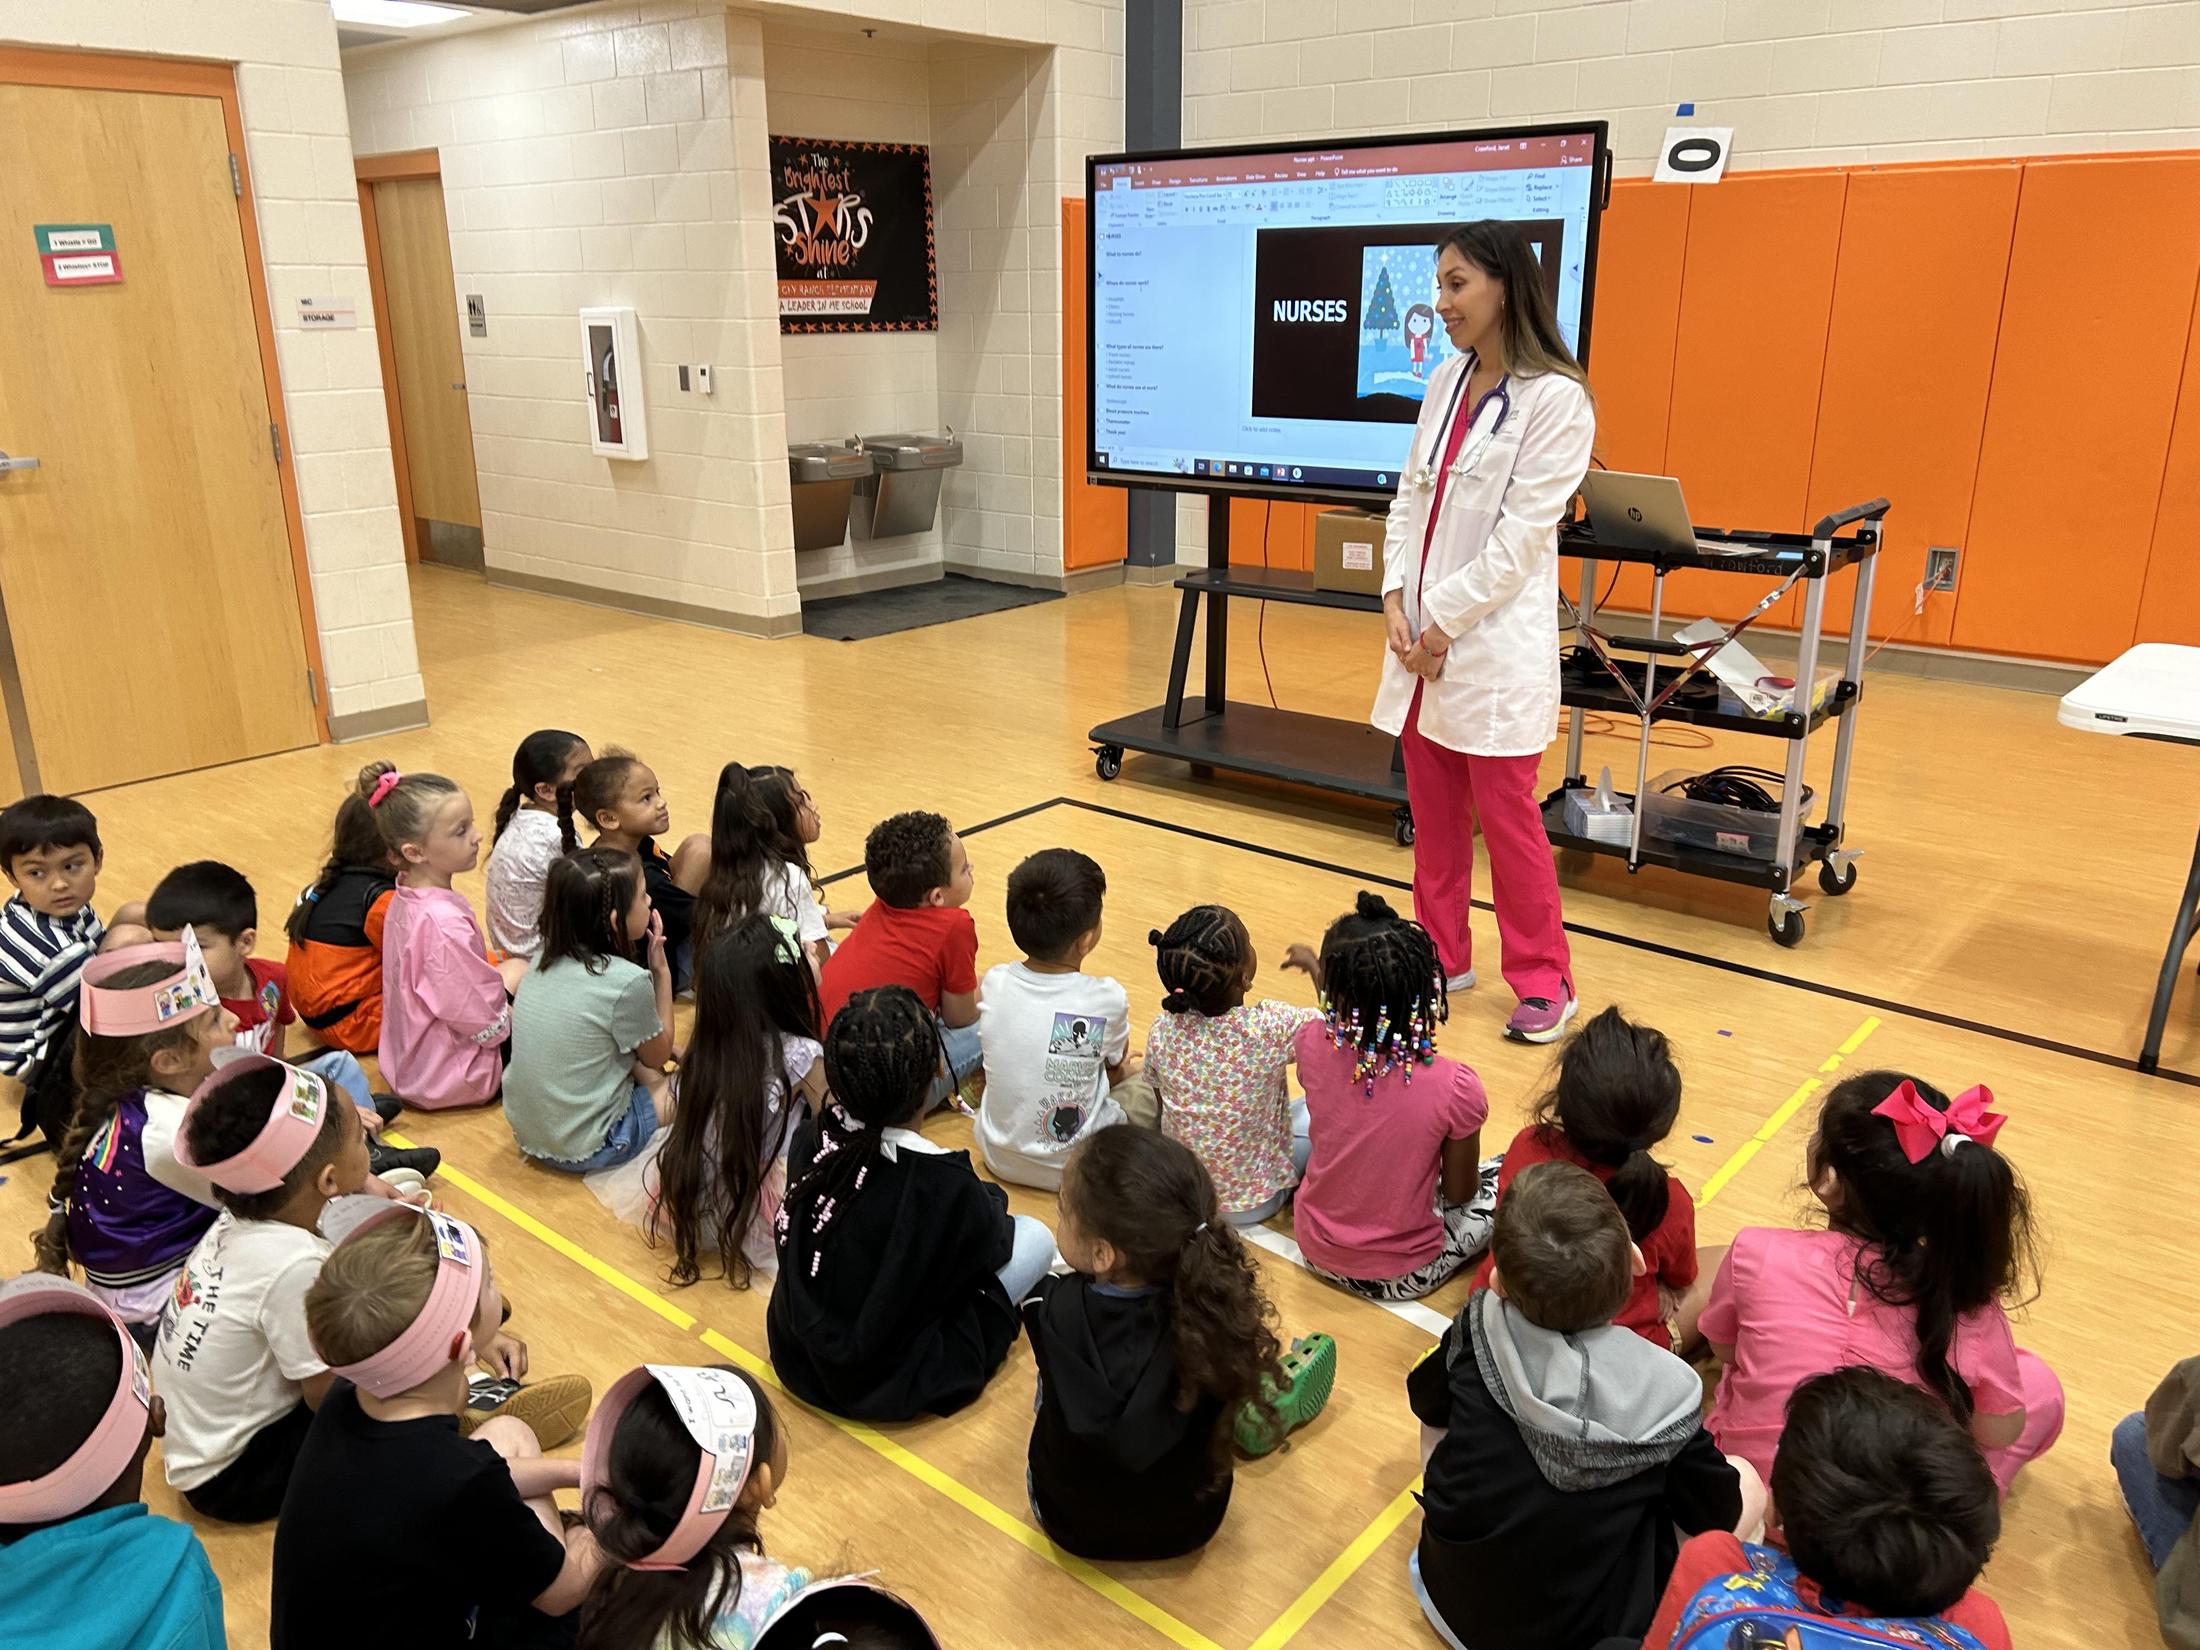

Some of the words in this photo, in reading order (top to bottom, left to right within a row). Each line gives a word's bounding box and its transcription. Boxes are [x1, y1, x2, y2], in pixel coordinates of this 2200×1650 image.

[810, 152, 829, 167] The
[784, 166, 850, 193] Brightest
[795, 232, 850, 265] Shine
[817, 266, 827, 279] at
[780, 301, 785, 312] A
[788, 299, 816, 311] LEADER
[817, 300, 827, 311] IN
[829, 300, 840, 311] ME
[842, 300, 868, 311] SCHOOL
[1273, 299, 1348, 322] NURSES
[1628, 506, 1642, 522] hp
[202, 1267, 223, 1314] THE
[177, 1319, 209, 1372] TIME
